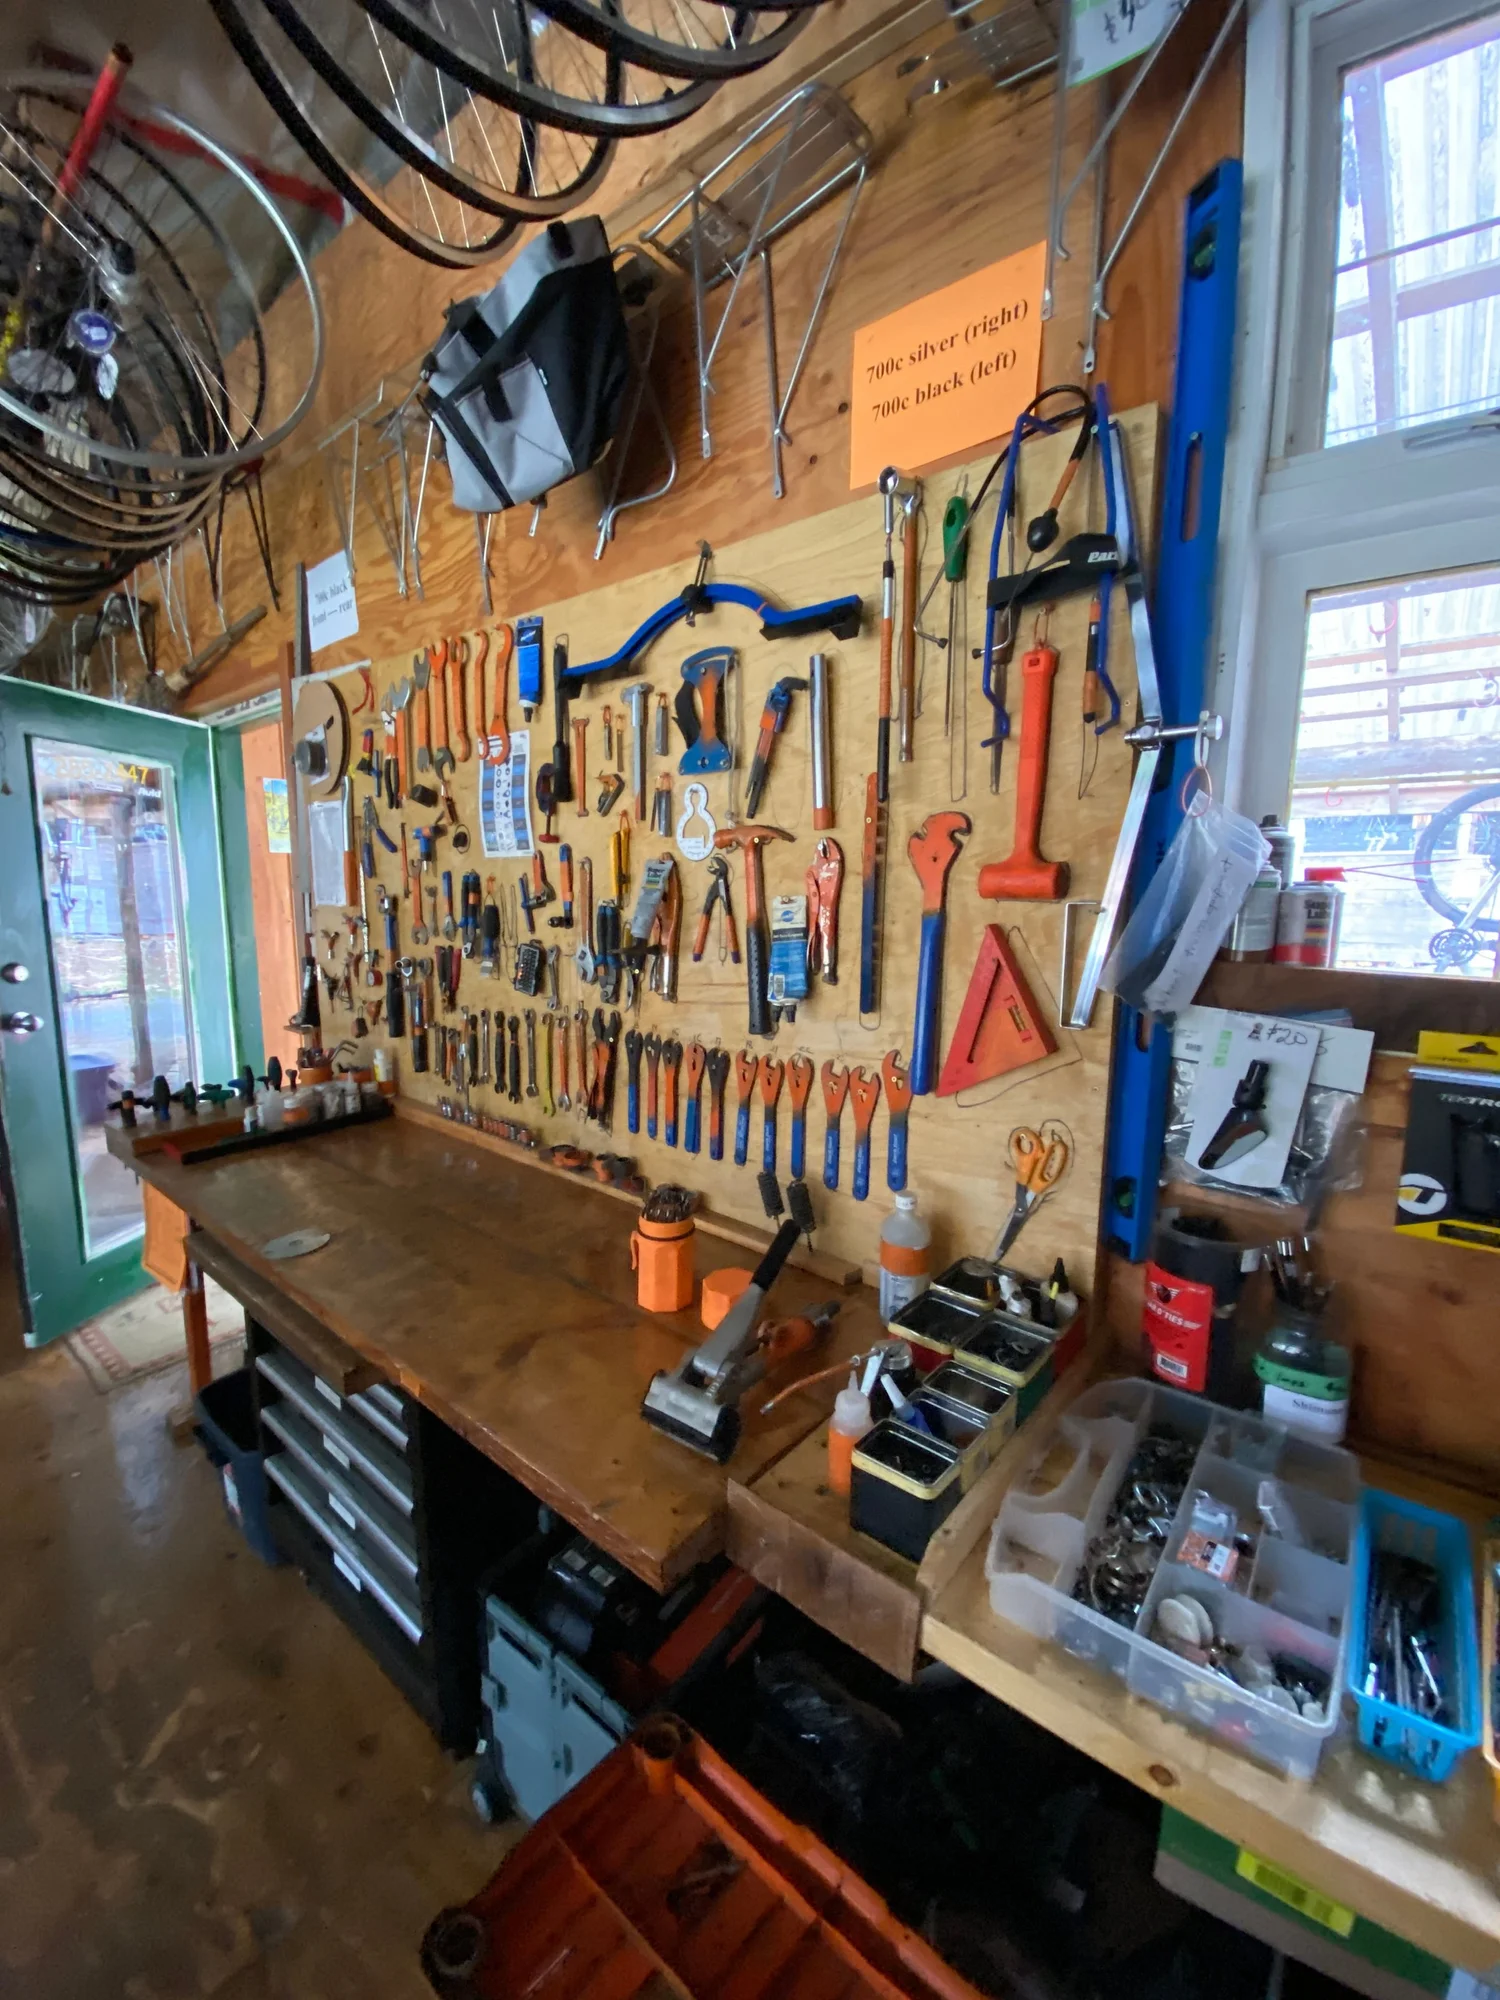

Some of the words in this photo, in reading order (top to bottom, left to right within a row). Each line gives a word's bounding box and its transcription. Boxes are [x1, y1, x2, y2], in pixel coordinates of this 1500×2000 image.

[866, 356, 904, 384] 700c
[908, 332, 959, 366] silver
[964, 299, 1028, 345] (right)
[871, 395, 910, 422] 700c
[915, 371, 964, 405] black
[970, 349, 1017, 385] (left)
[647, 866, 666, 875] Super
[1266, 1023, 1308, 1046] $20
